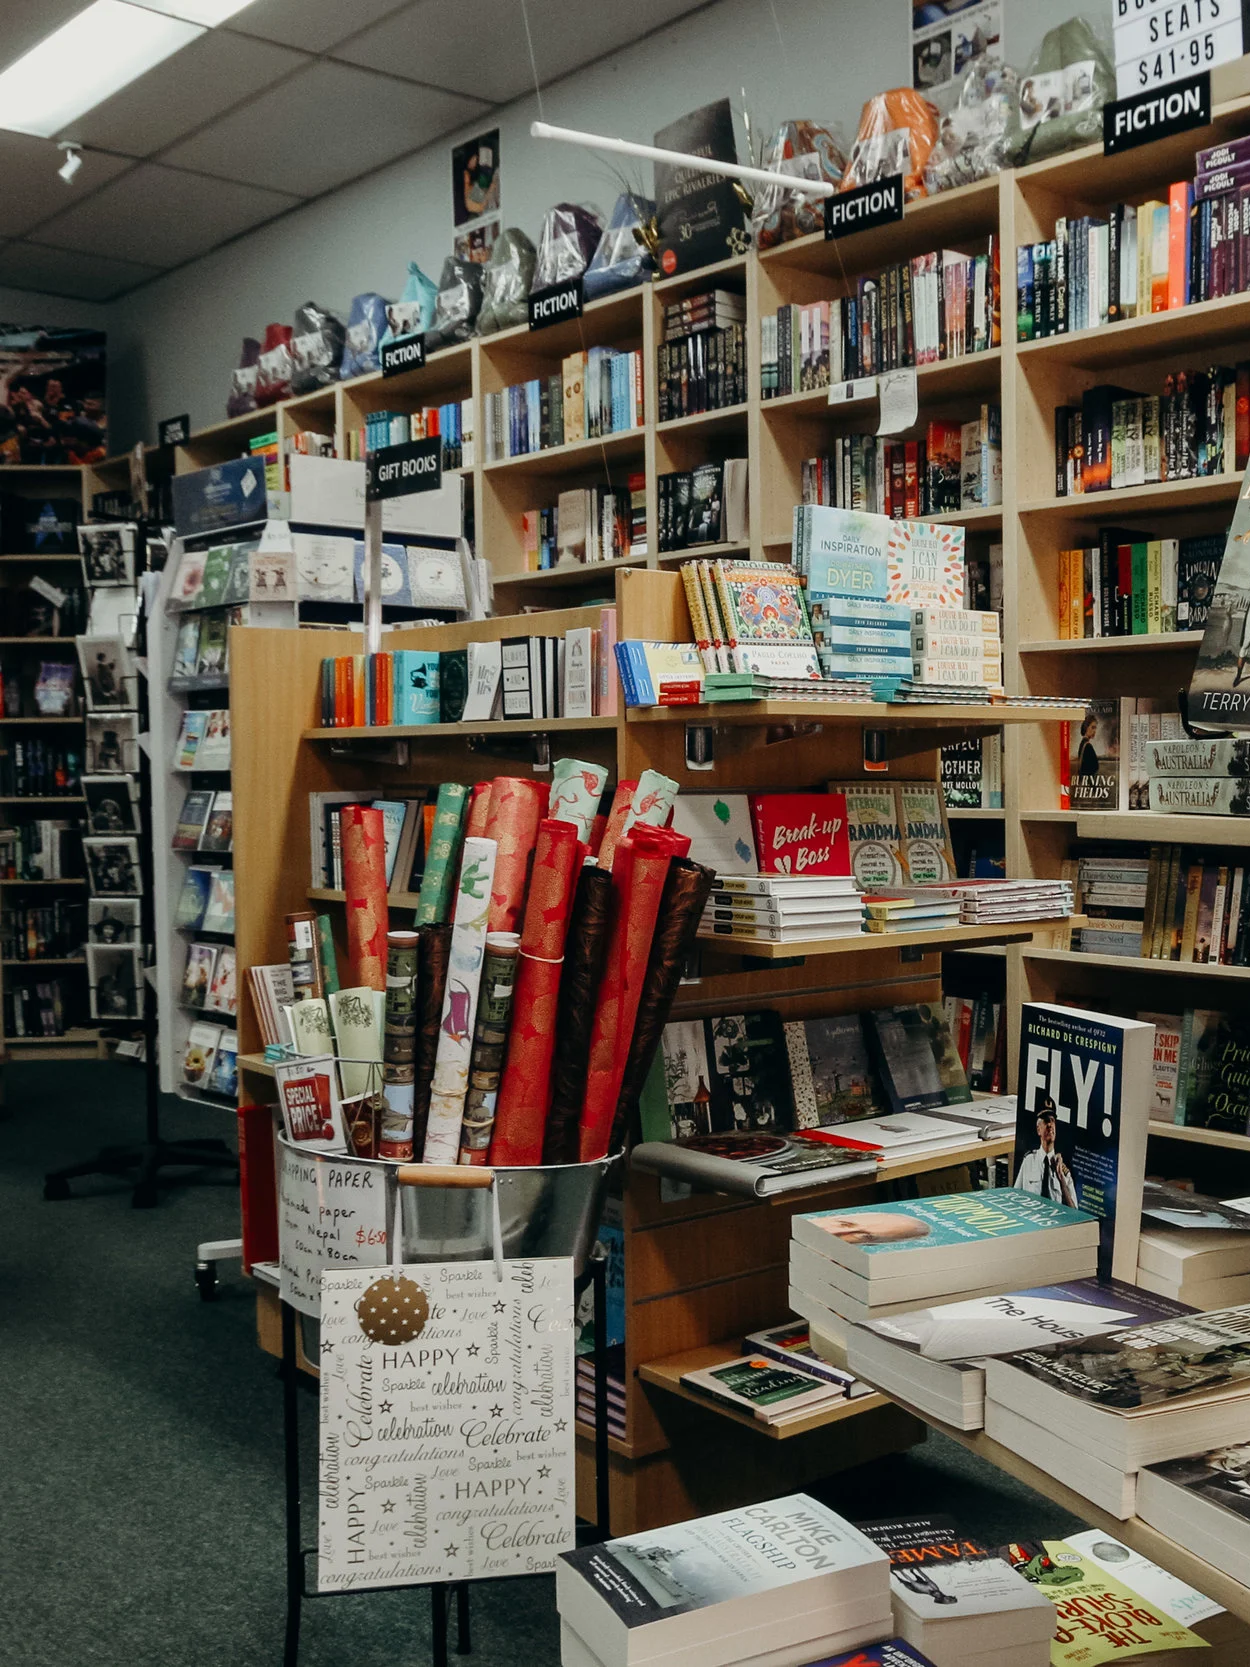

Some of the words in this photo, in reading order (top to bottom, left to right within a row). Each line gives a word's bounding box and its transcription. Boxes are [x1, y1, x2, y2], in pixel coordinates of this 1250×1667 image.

[1149, 0, 1220, 42] SEATS
[1115, 86, 1201, 136] FICTION
[1205, 152, 1236, 168] PICOULT
[1210, 148, 1229, 160] JODI
[832, 187, 897, 225] FICTION
[533, 289, 578, 320] FICTION
[385, 342, 422, 367] FICTION
[378, 460, 400, 481] GIFT
[402, 454, 437, 477] BOOKS
[820, 539, 882, 557] INSPIRATION
[842, 534, 861, 543] DAILY
[826, 567, 875, 590] DYER
[1160, 754, 1212, 770] AUSTRALIA
[1071, 774, 1116, 788] BURNING
[1074, 786, 1110, 800] FIELDS
[772, 813, 843, 851] Break-up
[796, 847, 830, 872] Boss
[1028, 1023, 1061, 1040] RICHARD
[1063, 1032, 1072, 1043] DE
[1075, 1035, 1117, 1055] CRESPIGNY
[286, 1084, 315, 1106] SPECIAL
[1024, 1043, 1115, 1138] FLY!
[290, 1103, 321, 1134] PRICE
[328, 1170, 374, 1188] PAPER
[319, 1206, 356, 1226] paper
[924, 1195, 1026, 1237] TURMOIL
[308, 1224, 341, 1247] Nepal
[984, 1297, 1025, 1317] The
[382, 1349, 460, 1369] HAPPY
[382, 1378, 427, 1393] Sparkle
[431, 1372, 507, 1397] celebration
[460, 1418, 552, 1449] Celebrate
[345, 1444, 466, 1472] congratulations
[744, 1507, 835, 1571] CARLTON
[785, 1511, 842, 1547] MIKE
[721, 1517, 797, 1572] FLAGSHIP
